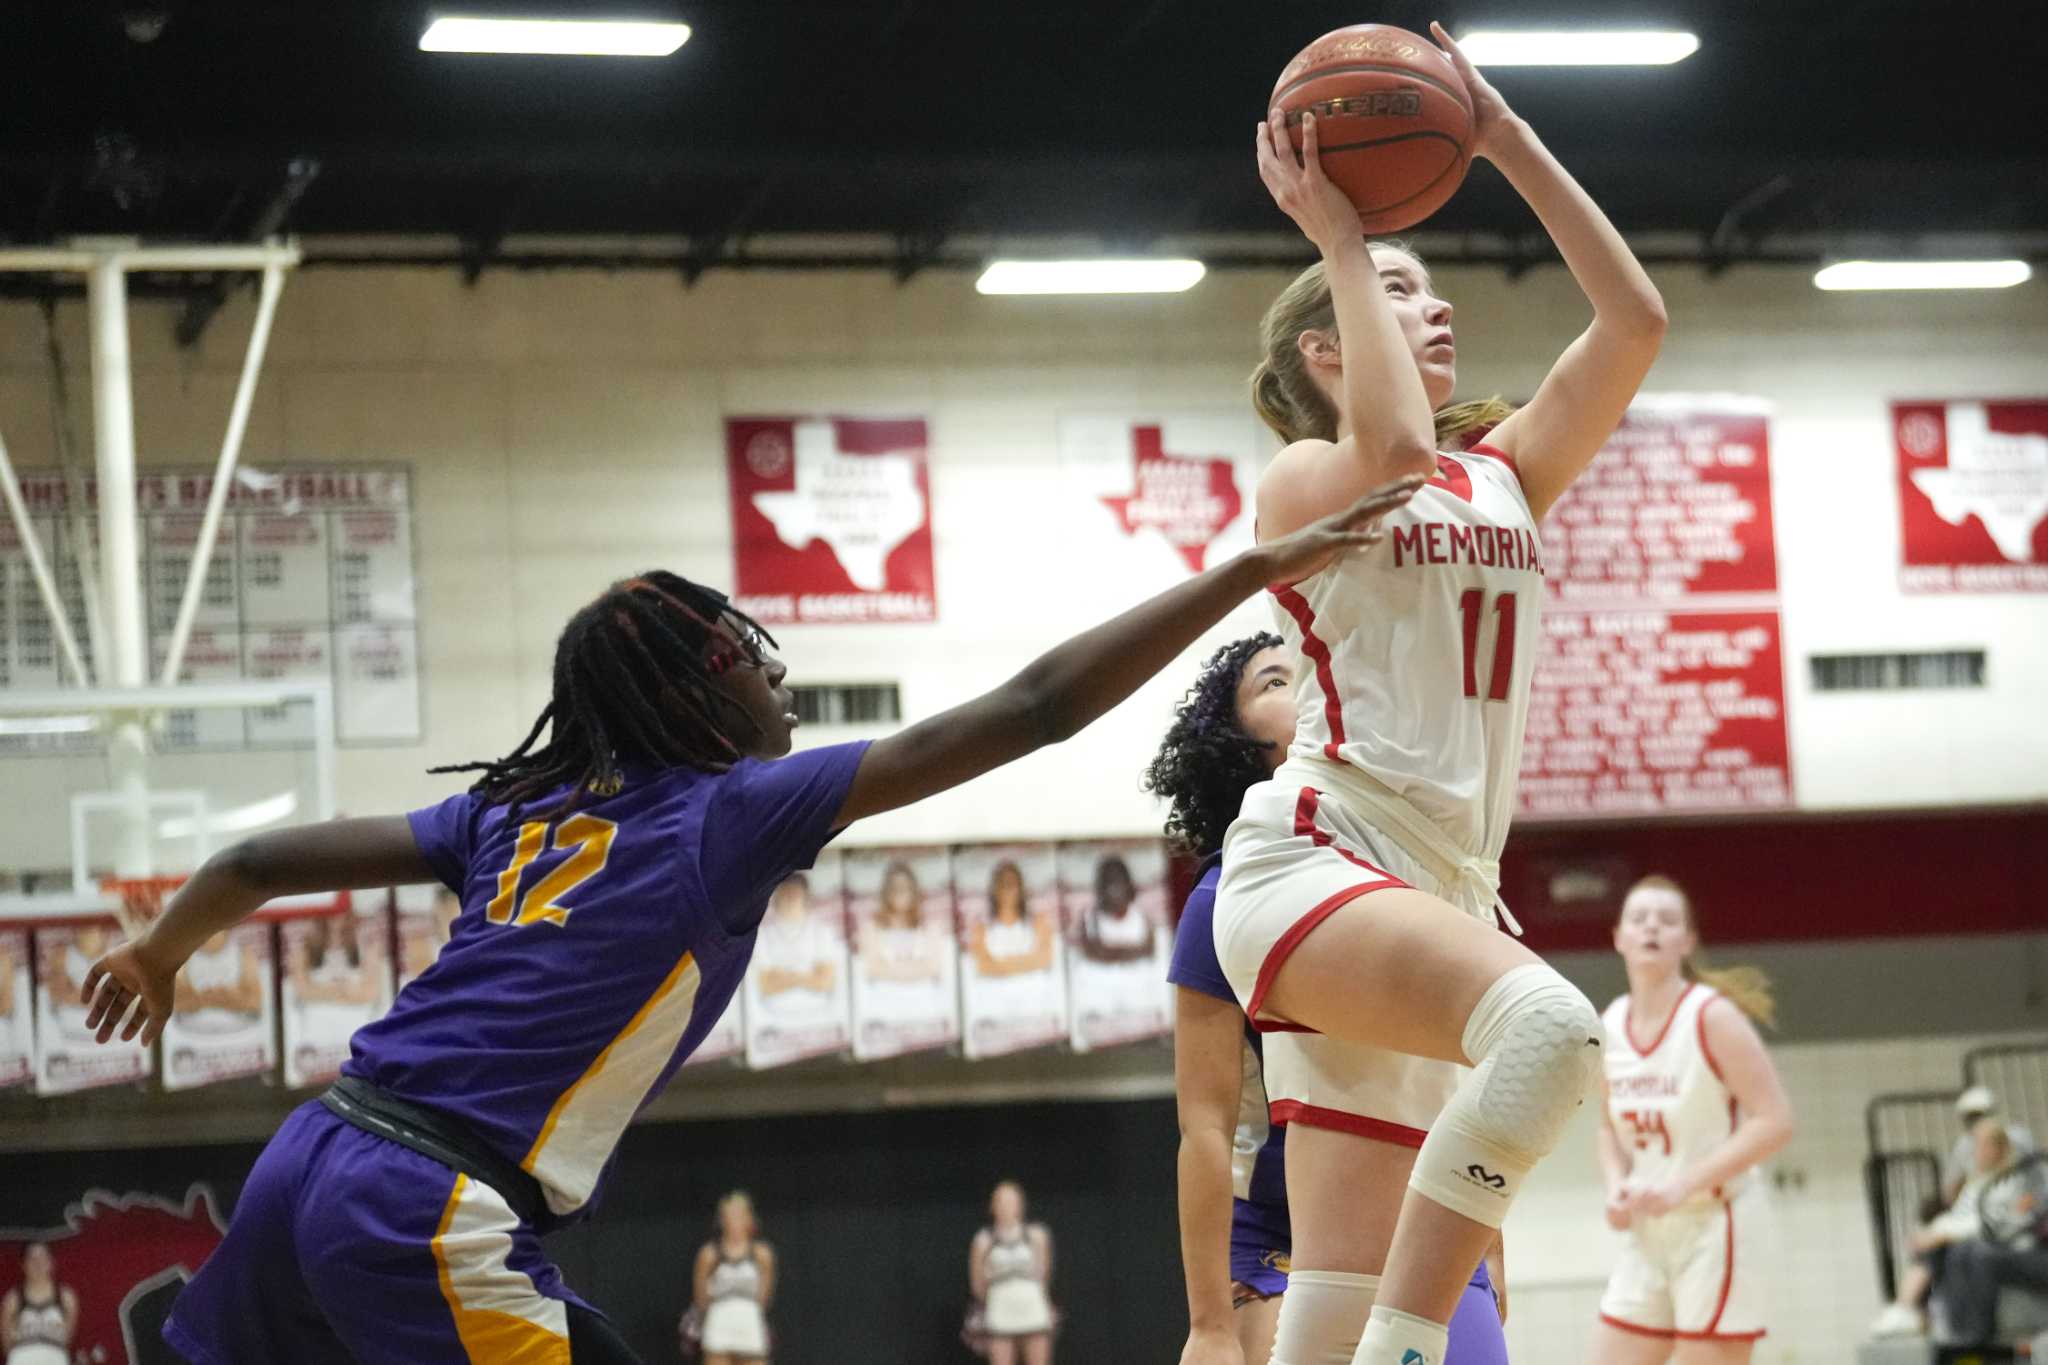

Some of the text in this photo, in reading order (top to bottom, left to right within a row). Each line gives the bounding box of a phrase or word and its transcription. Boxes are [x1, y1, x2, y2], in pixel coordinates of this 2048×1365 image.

[178, 472, 370, 503] BAKETBALL
[1393, 523, 1544, 575] MEMORIA
[1458, 588, 1516, 702] 11
[486, 812, 618, 928] 12
